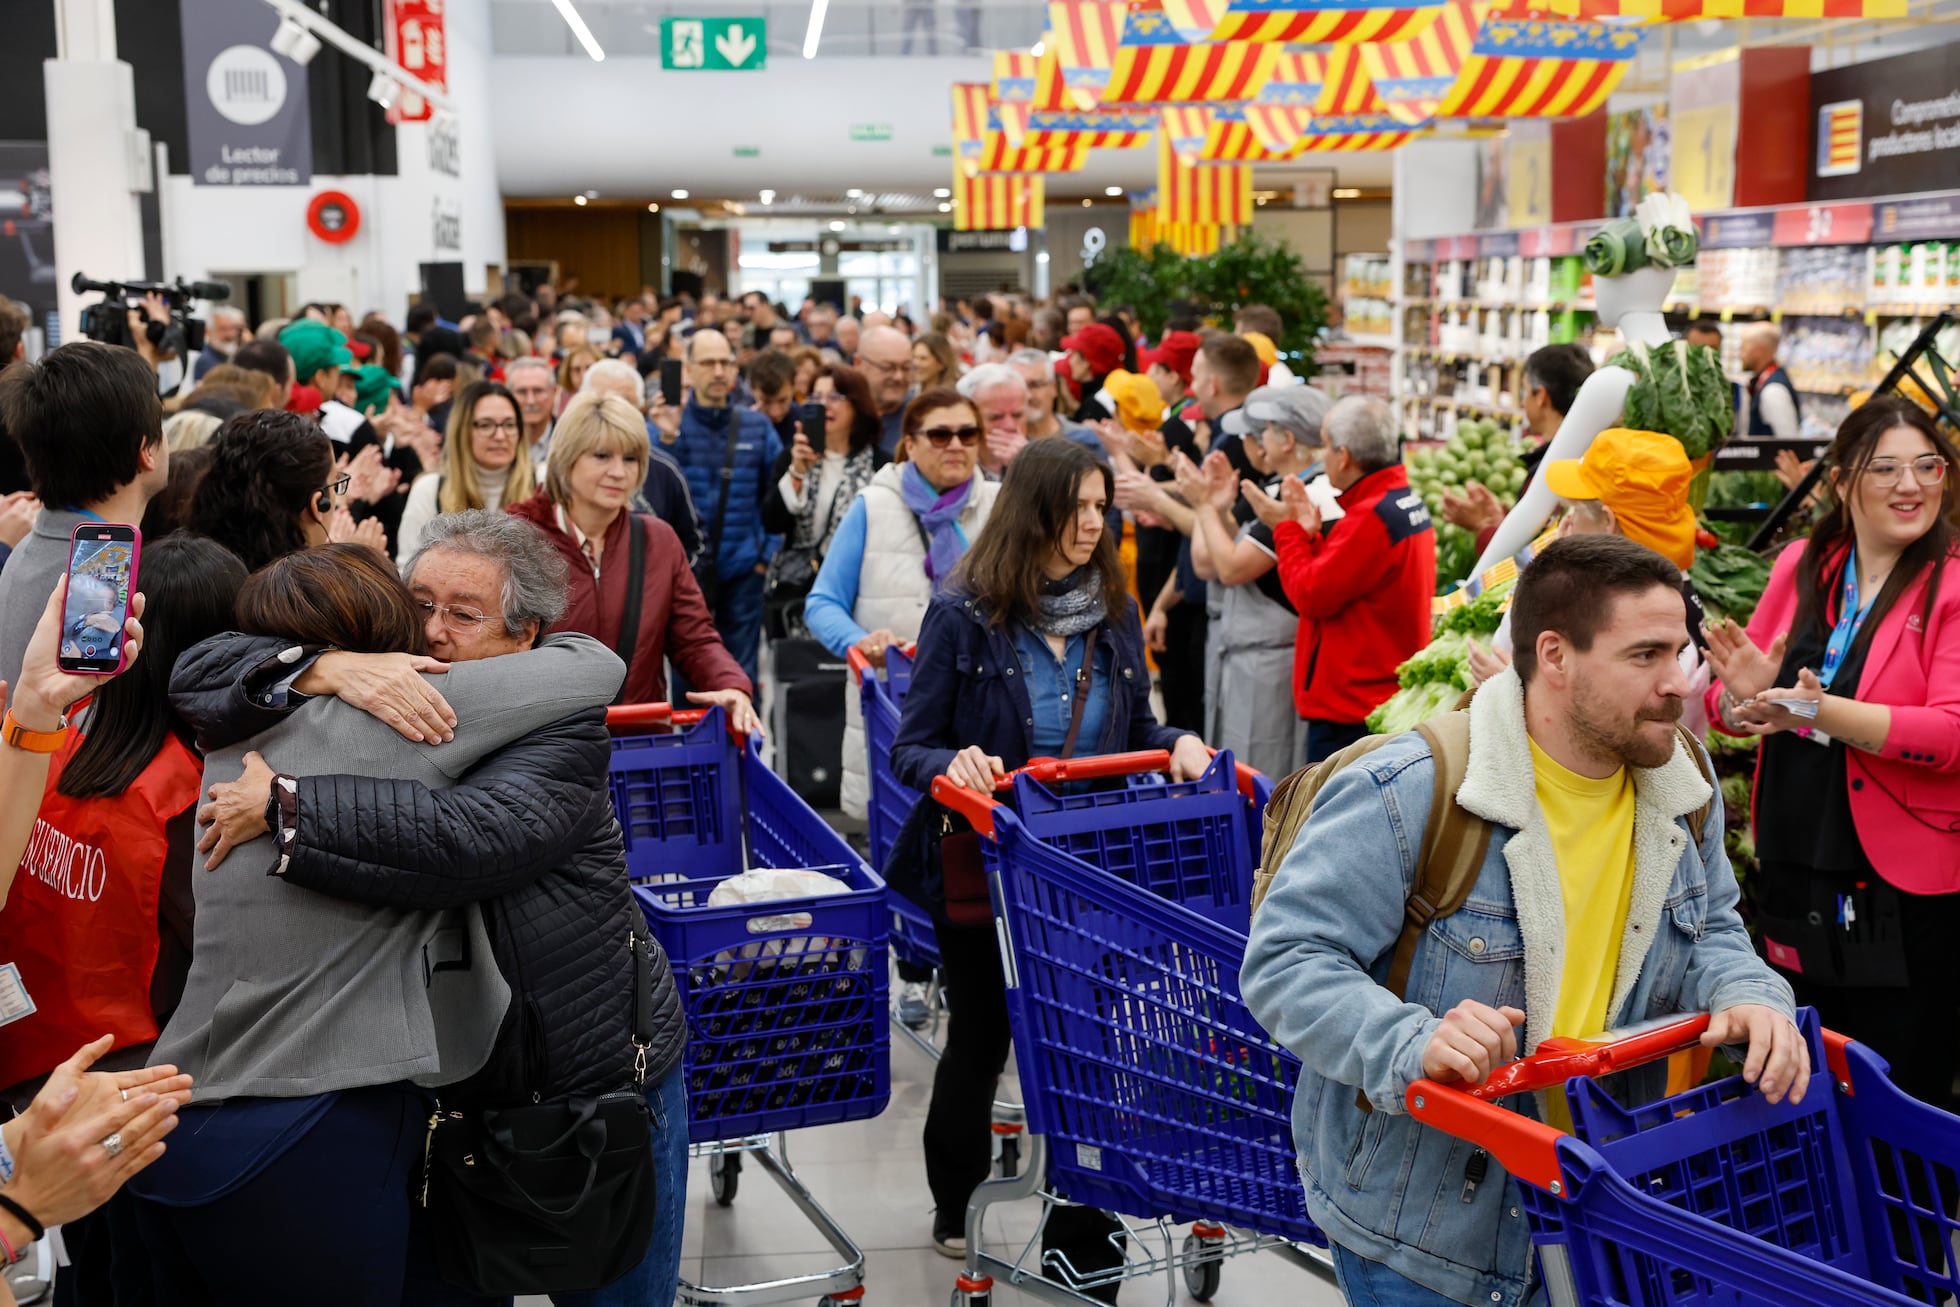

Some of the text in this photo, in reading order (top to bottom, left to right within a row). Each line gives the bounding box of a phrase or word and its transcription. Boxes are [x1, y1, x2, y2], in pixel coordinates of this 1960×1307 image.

[222, 144, 280, 165] Lector
[205, 164, 299, 186] de precios
[39, 826, 106, 902] SERVICIO
